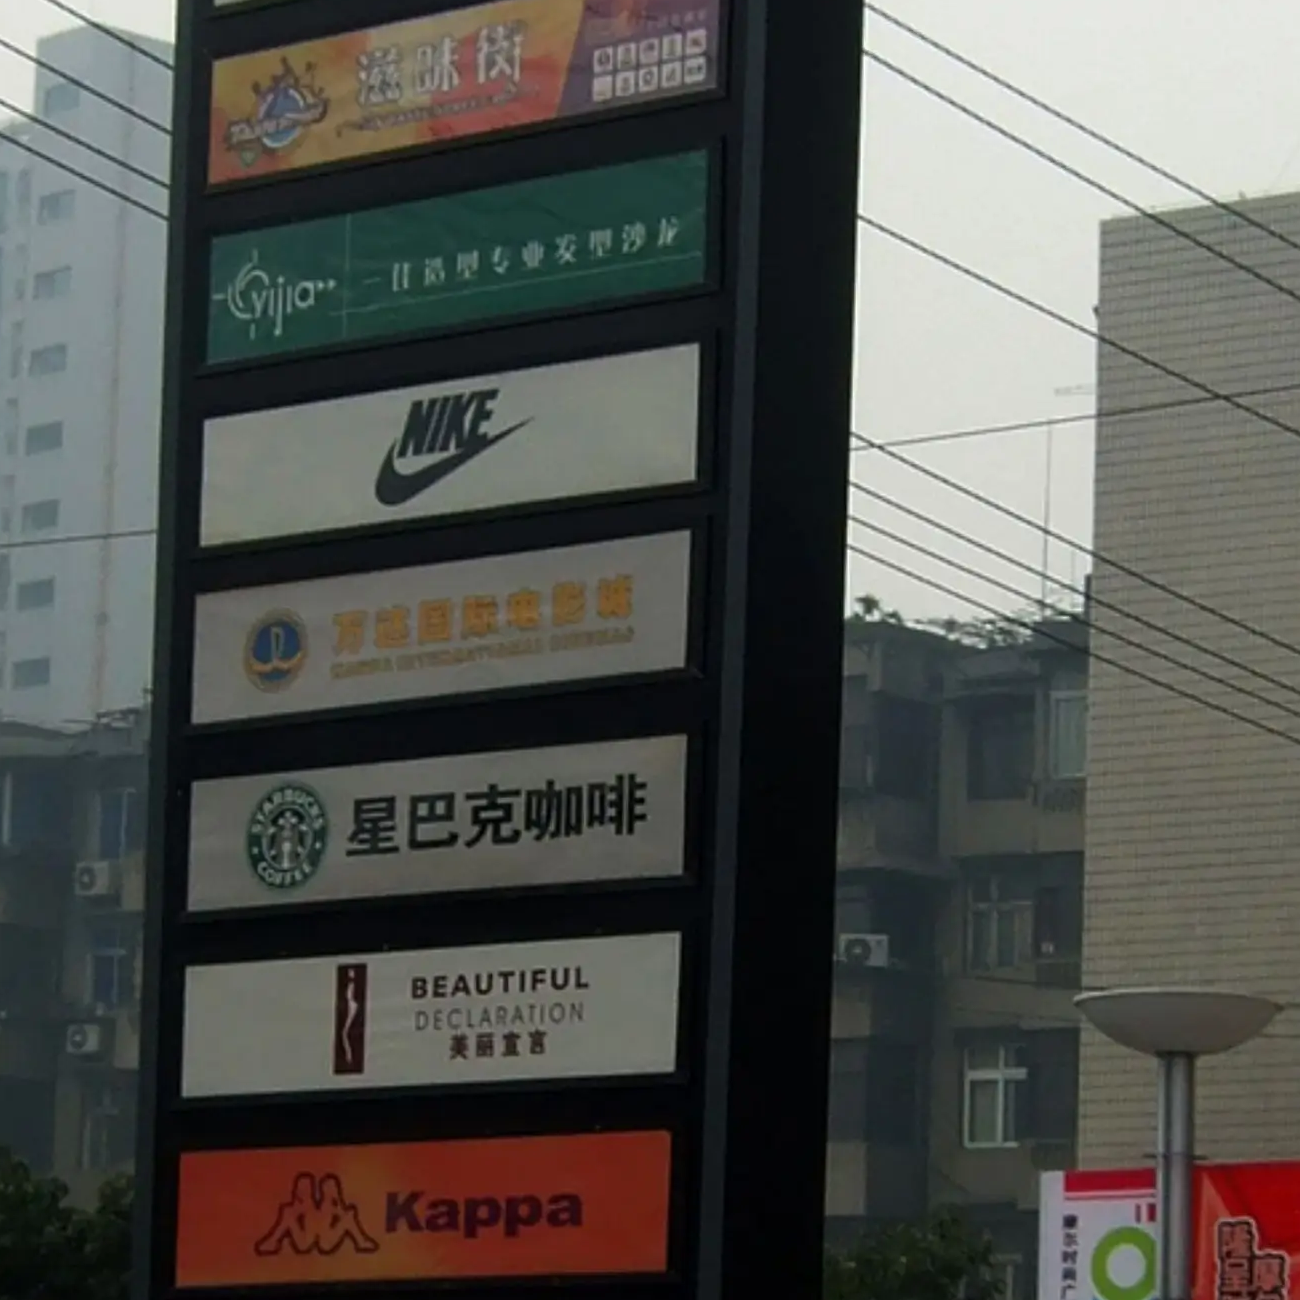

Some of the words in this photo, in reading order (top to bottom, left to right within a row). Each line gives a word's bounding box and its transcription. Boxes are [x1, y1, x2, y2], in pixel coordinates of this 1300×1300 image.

[396, 388, 500, 459] NIKE
[331, 573, 635, 657] 万达国际电影城
[345, 773, 648, 857] 星巴克咖啡
[411, 965, 591, 1000] BEAUTIFUL
[414, 1001, 585, 1032] DECLARATION
[449, 1029, 548, 1060] 美丽宣言
[384, 1191, 584, 1239] Kappa
